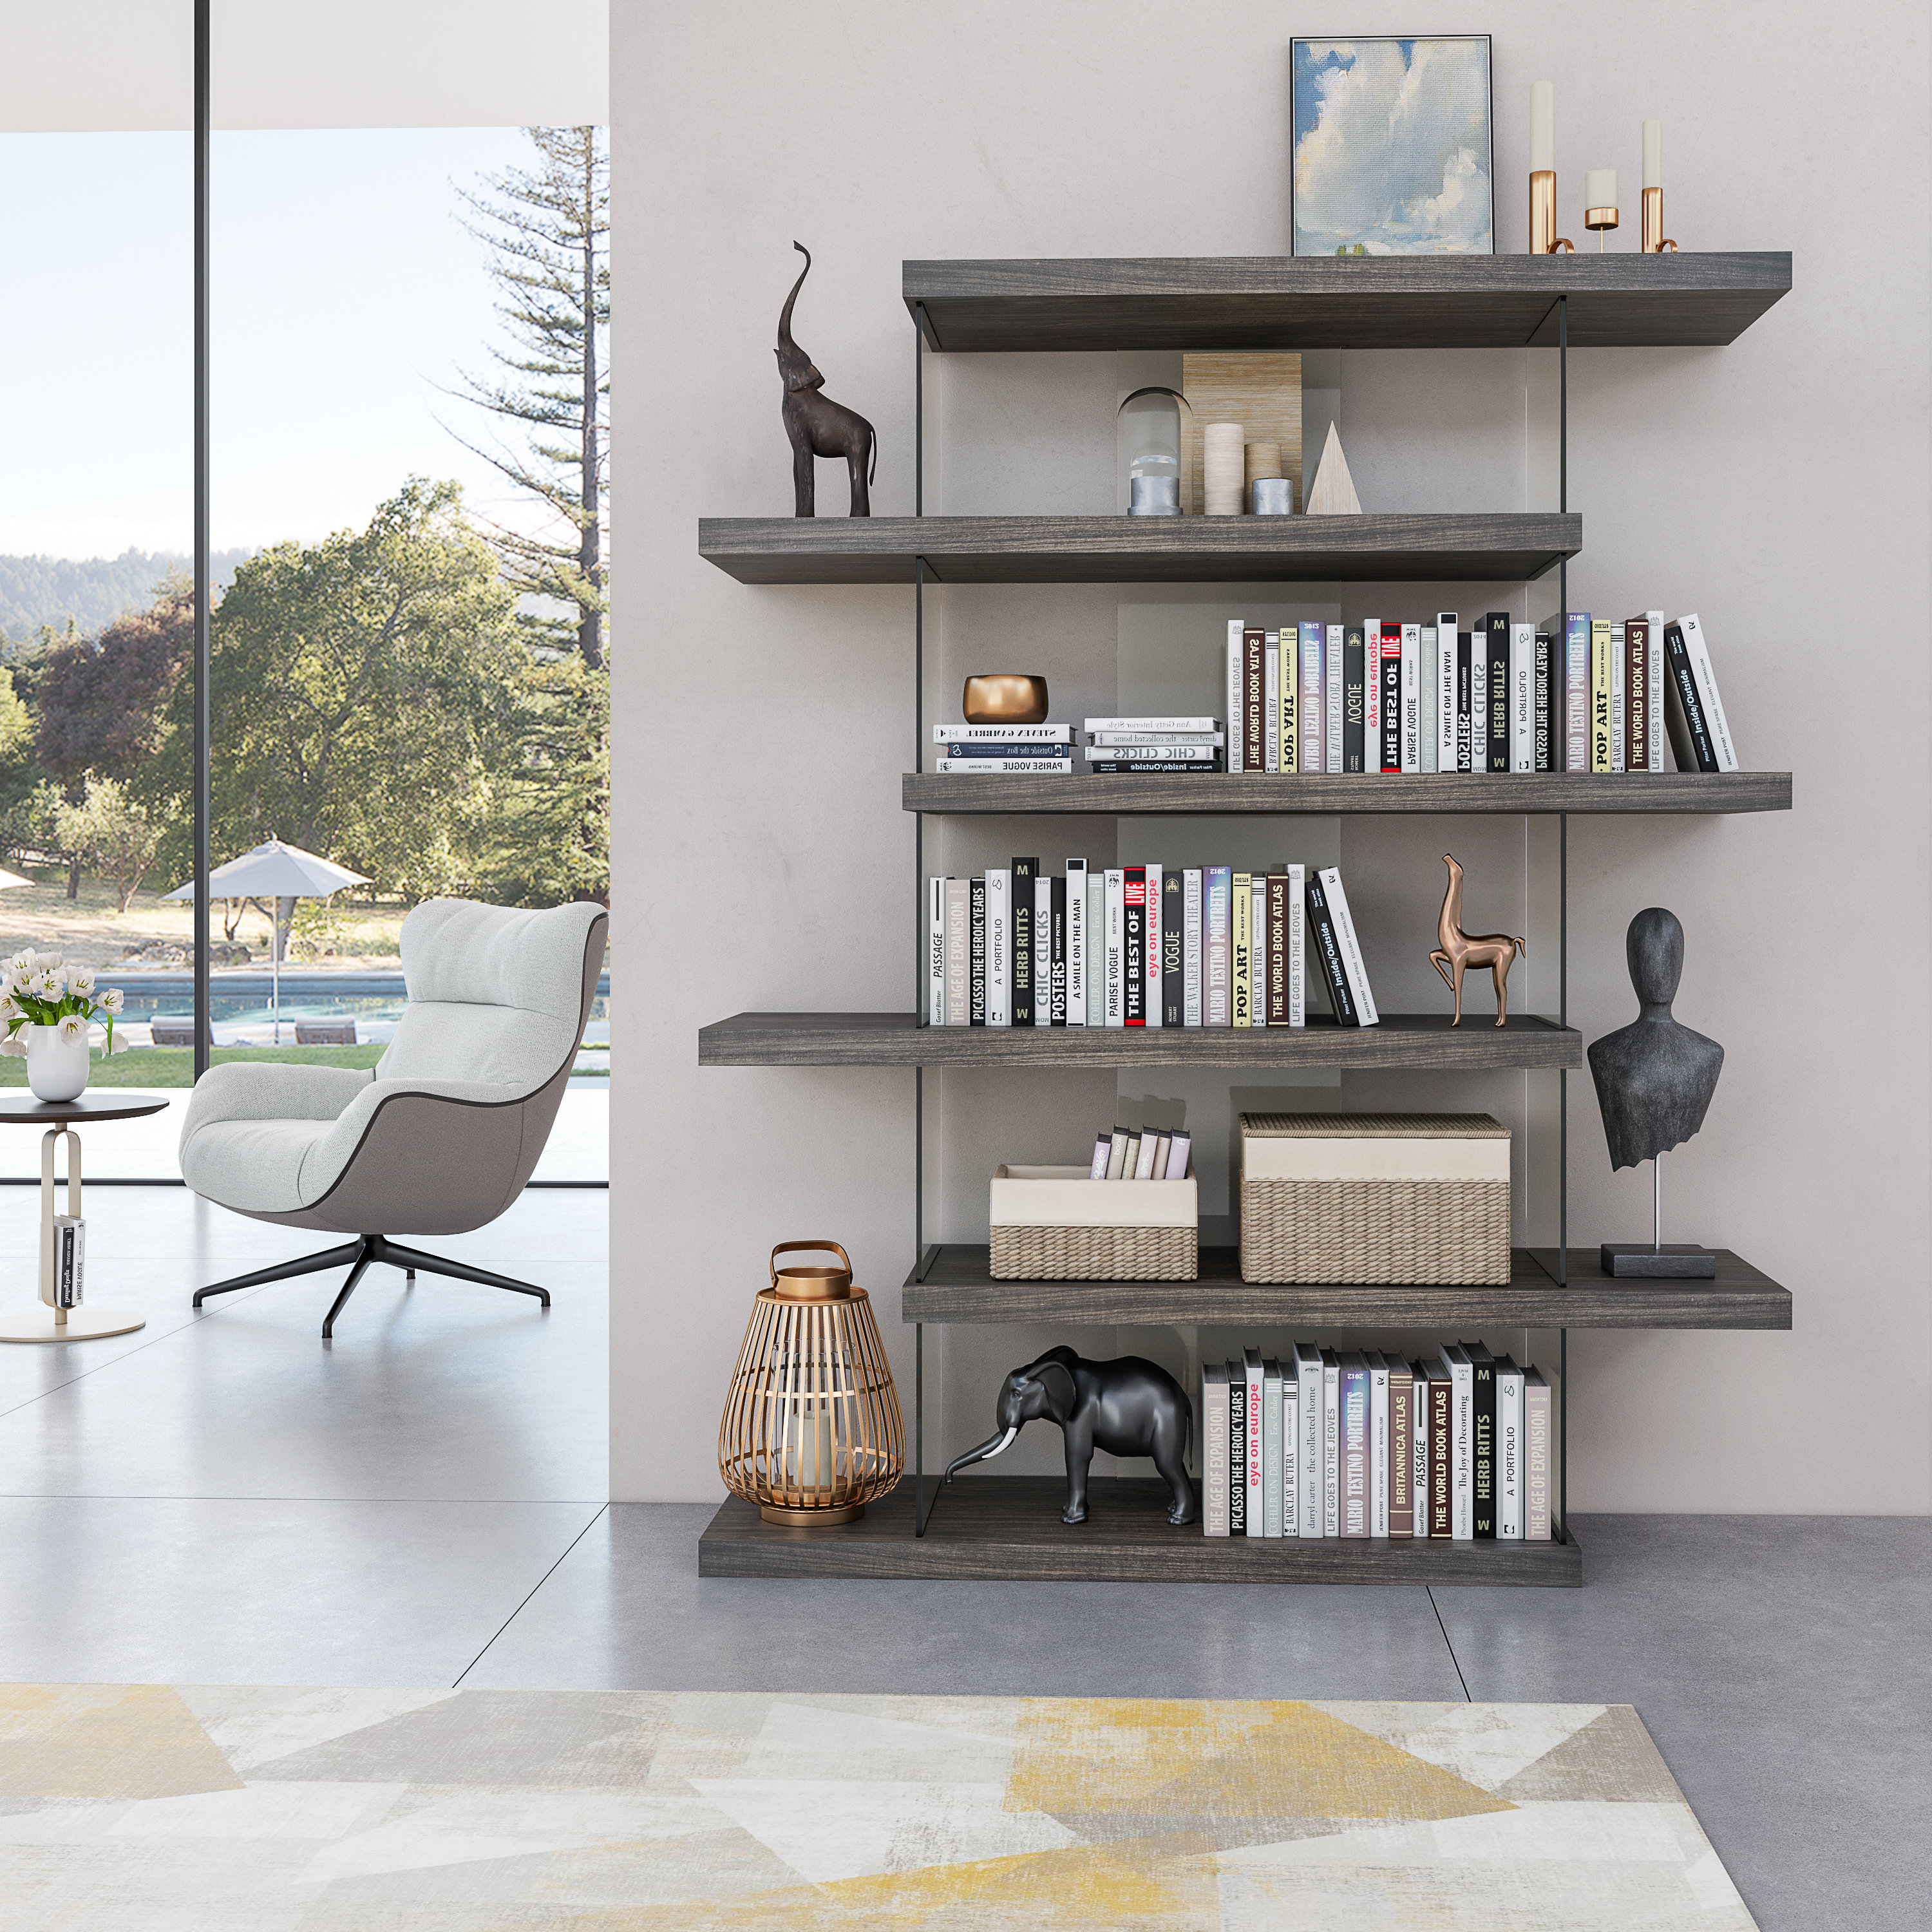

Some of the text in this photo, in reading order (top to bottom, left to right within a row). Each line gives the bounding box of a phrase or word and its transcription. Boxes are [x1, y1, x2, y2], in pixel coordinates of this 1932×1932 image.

[1569, 633, 1585, 770] MARIO TESTINO PORTREITS
[1633, 631, 1643, 764] THE WORLD BOOK ATLAS
[1680, 670, 1703, 733] Inside/Outside
[1597, 691, 1607, 764] POP ART
[951, 902, 964, 960] EXPANSION
[973, 888, 983, 1019] PICASSO THE HEROIC YEARS
[1017, 908, 1028, 988] HERB RITTS
[1074, 945, 1080, 958] ON
[1091, 936, 1099, 968] DESIGN
[1126, 884, 1144, 1016] THE BEST OF LIVE
[1150, 880, 1159, 977] eye on europe
[1166, 931, 1179, 973] VOGUE
[1188, 881, 1198, 1023] THE WALKER STORY THEATER
[1210, 886, 1226, 1022] MARIO TESTINO PORTREITS
[1321, 923, 1343, 986] Inside/Outside
[934, 933, 942, 978] PASSAGE
[951, 963, 963, 976] OF
[1037, 911, 1048, 1006] CHIC CLICKS
[1091, 970, 1099, 984] ON
[1110, 947, 1118, 1016] PARISE VOGUE
[1237, 945, 1247, 1018] POP ART
[1293, 961, 1300, 972] TO
[951, 979, 963, 999] AGE
[951, 1001, 963, 1021] THE
[1052, 962, 1065, 1019] POSTERS
[1091, 987, 1100, 1022] COHLER
[1113, 1137, 1122, 1155] book
[1307, 1387, 1315, 1412] home
[1459, 1396, 1469, 1443] Decorating
[1307, 1416, 1315, 1455] collected
[1396, 1396, 1405, 1504] BRITANNICA ATLAS
[1436, 1392, 1446, 1528] THE WORLD BOOK ATLAS
[1459, 1446, 1466, 1455] of
[1478, 1415, 1490, 1498] HERB RITTS
[1307, 1459, 1315, 1472] the
[1416, 1440, 1425, 1486] PASSAGE
[1459, 1457, 1469, 1472] Joy
[1308, 1506, 1317, 1528] darryl
